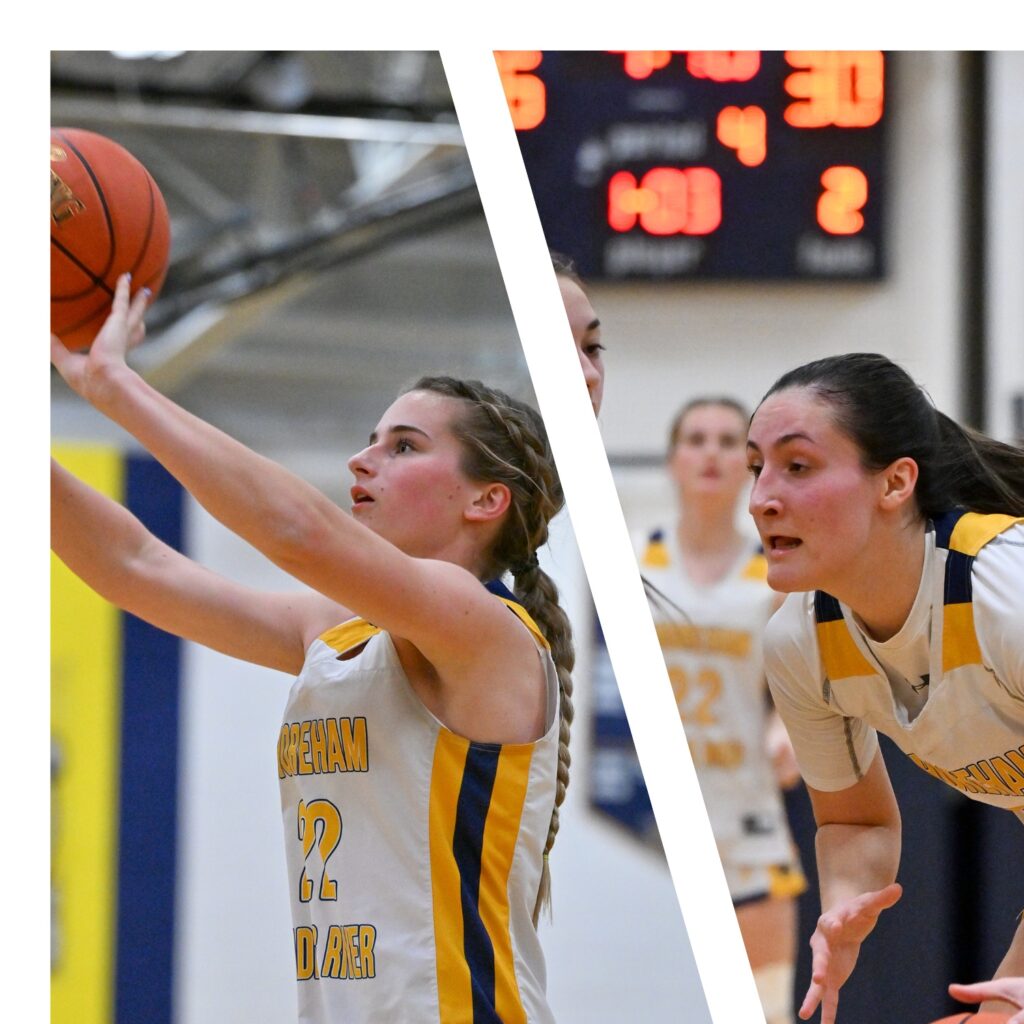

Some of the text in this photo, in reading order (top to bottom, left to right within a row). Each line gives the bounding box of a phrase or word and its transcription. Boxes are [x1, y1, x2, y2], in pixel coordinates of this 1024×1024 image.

[784, 50, 884, 128] 30
[717, 105, 766, 167] 4
[817, 166, 868, 235] 2
